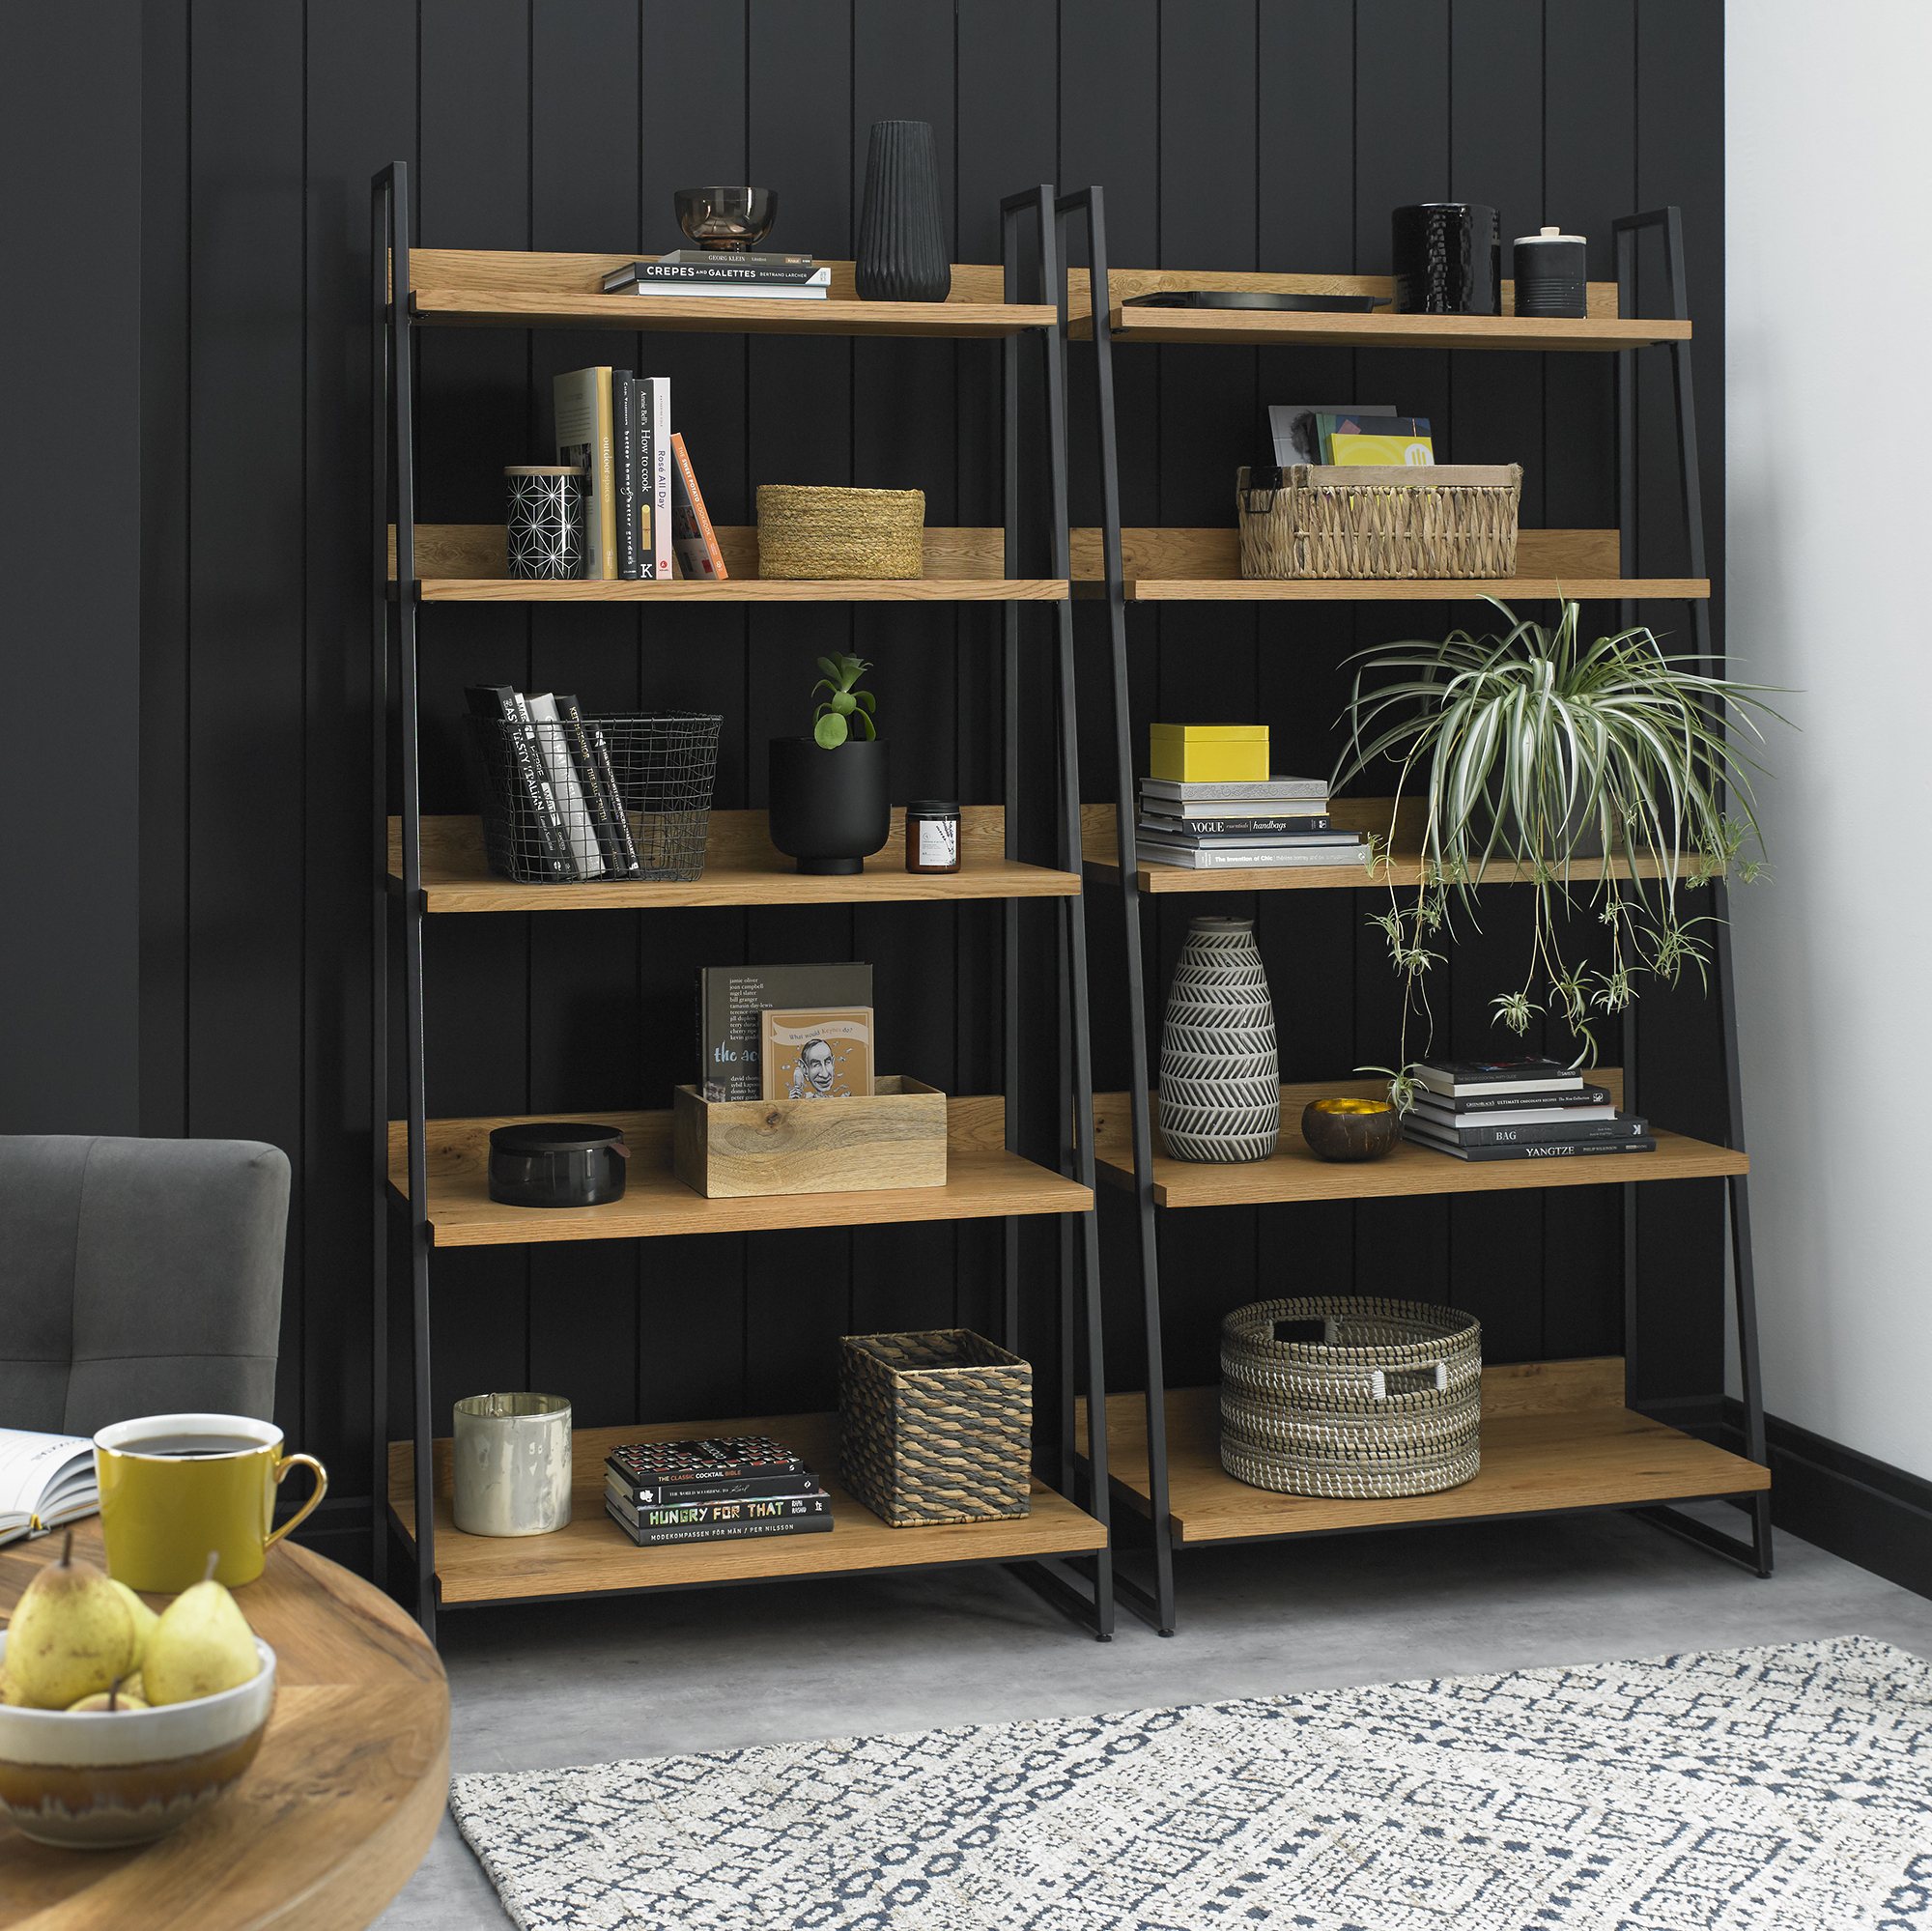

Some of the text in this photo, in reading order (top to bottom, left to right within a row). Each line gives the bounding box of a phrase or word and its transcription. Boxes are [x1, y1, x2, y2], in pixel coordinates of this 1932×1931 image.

[646, 266, 695, 277] CREPES
[708, 269, 756, 278] GALETTES
[640, 429, 651, 454] How
[641, 456, 649, 467] to
[657, 450, 666, 473] Rosé
[641, 468, 652, 493] cook
[682, 458, 692, 479] SWEET
[689, 479, 700, 502] POTATO
[657, 491, 666, 509] Day
[639, 564, 653, 579] K
[517, 702, 532, 733] MARO
[1191, 822, 1224, 833] VOGUE
[1252, 821, 1287, 832] handbags
[804, 1030, 821, 1038] would
[714, 1039, 758, 1063] the ac
[1496, 1130, 1517, 1141] BAG
[1526, 1146, 1575, 1157] YANGTZE
[649, 1501, 784, 1525] HUNGRY FOR THAT
[651, 1531, 710, 1540] MODEKOMPASSEN
